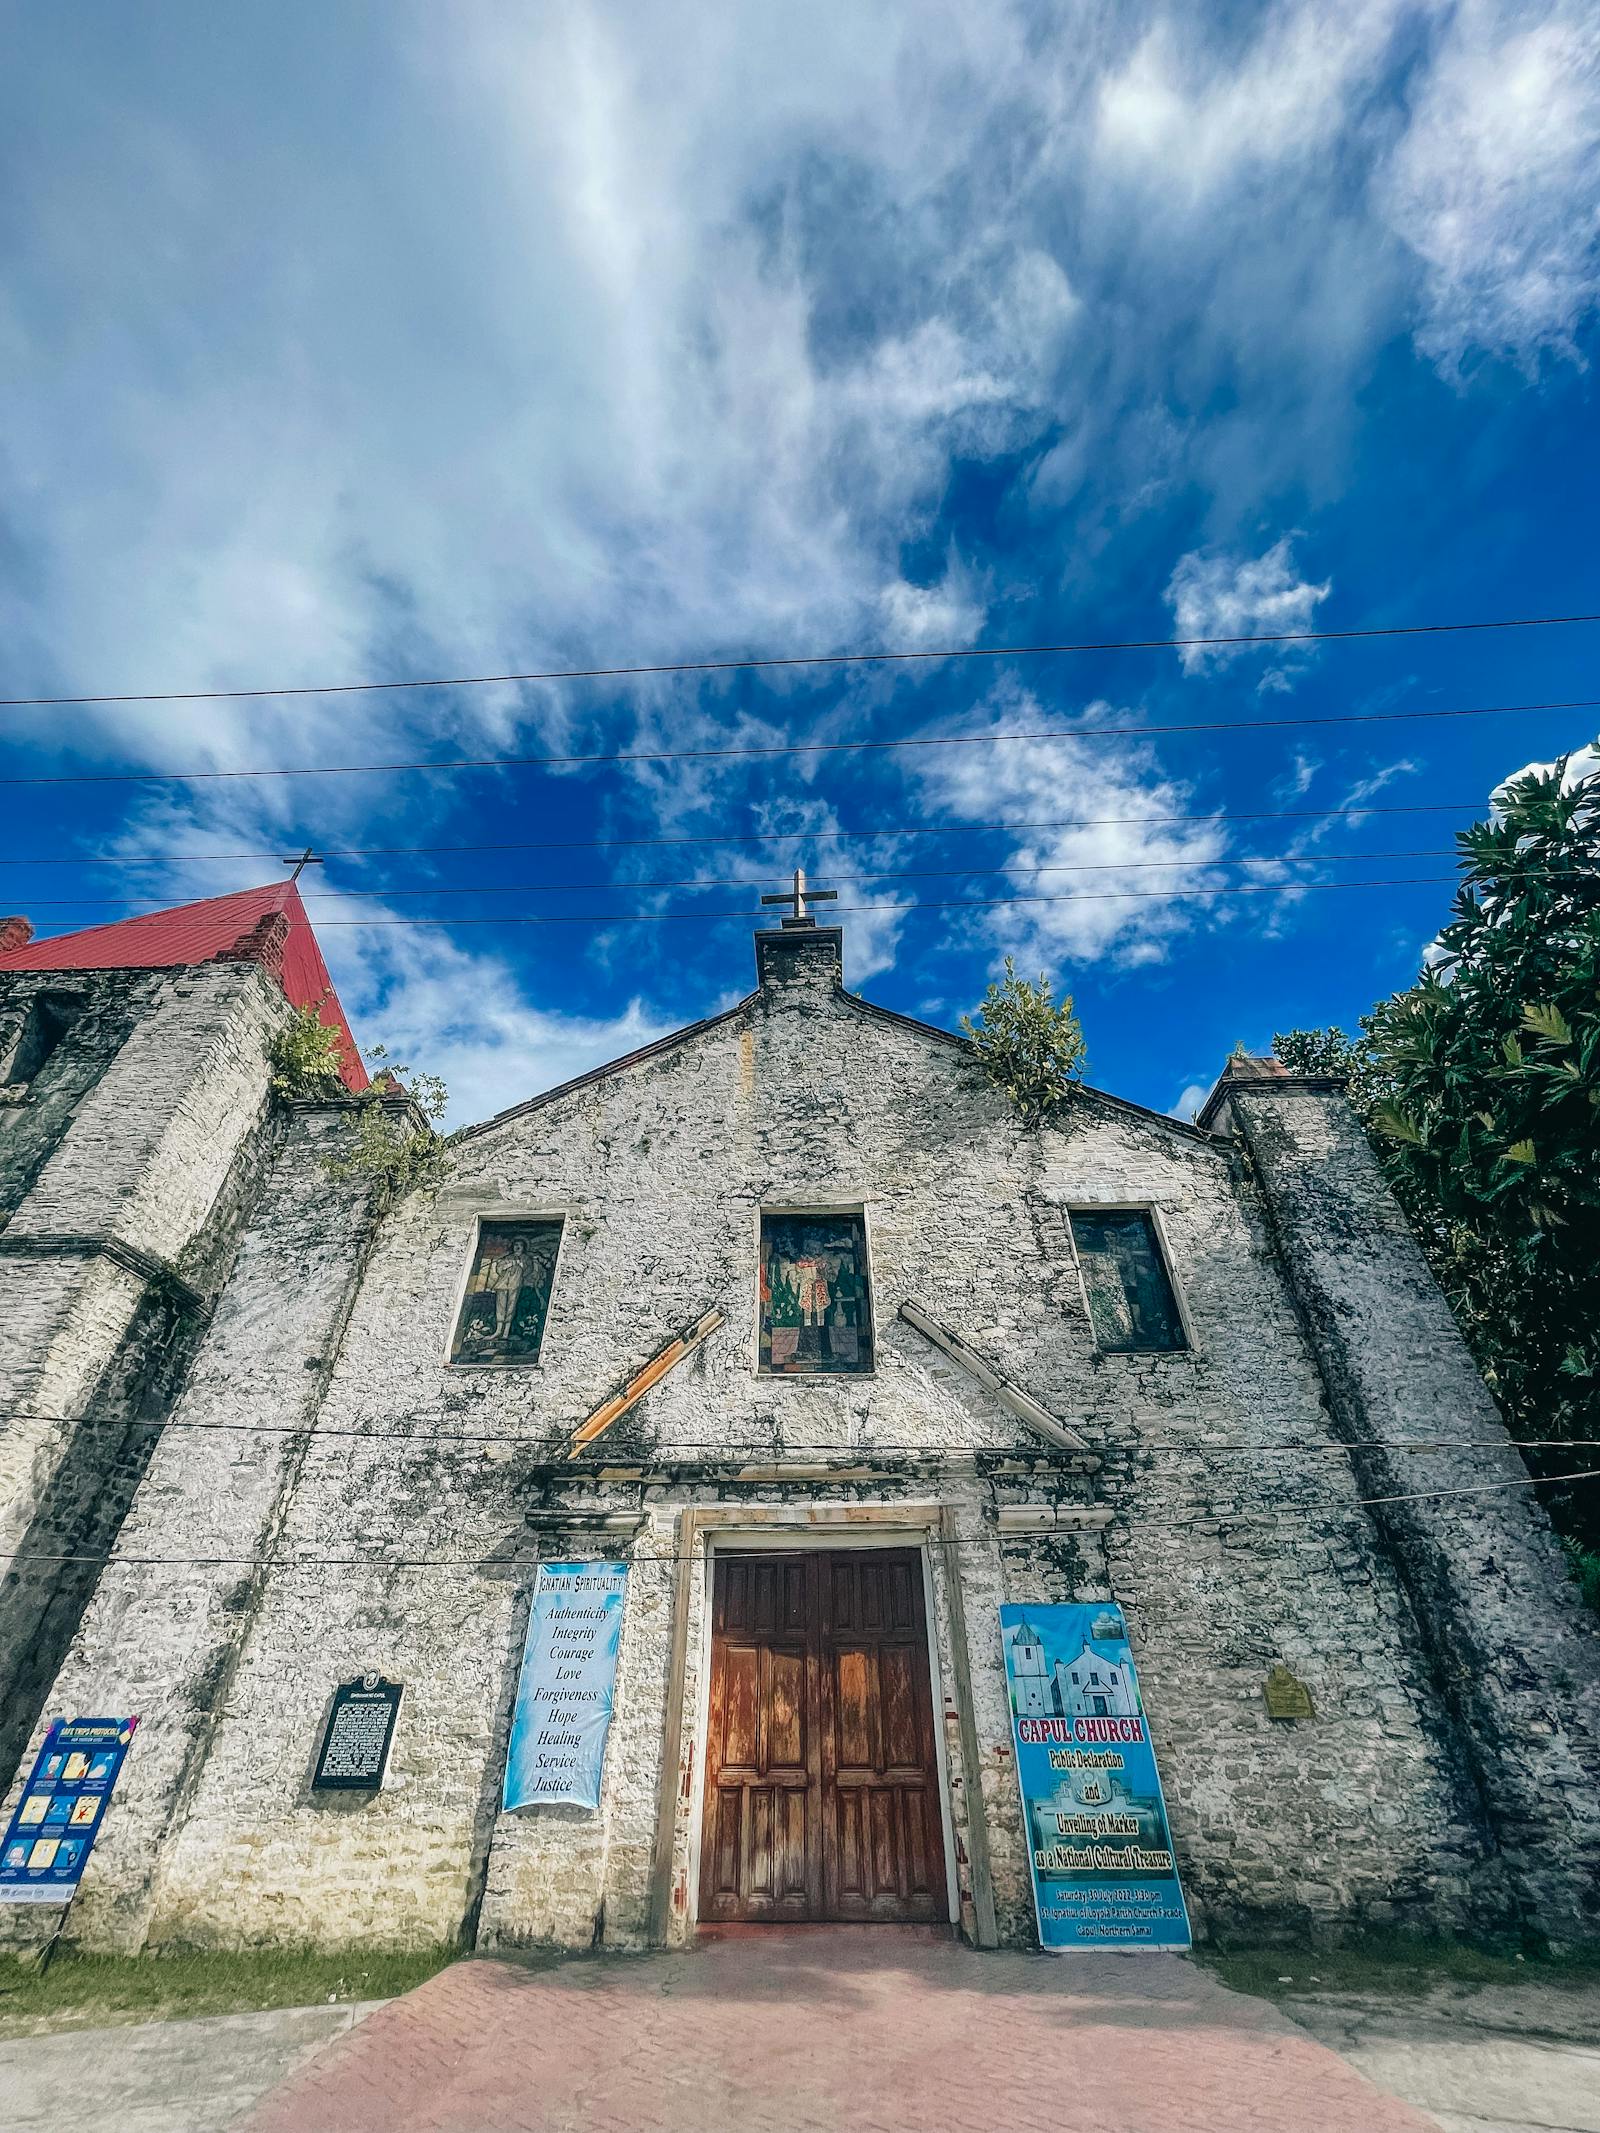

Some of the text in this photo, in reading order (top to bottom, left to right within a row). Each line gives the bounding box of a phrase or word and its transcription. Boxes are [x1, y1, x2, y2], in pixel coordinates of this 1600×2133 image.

[539, 1575, 623, 1593] IGNATIAN SPIRITUALITY
[545, 1606, 609, 1622] Authenticity
[551, 1626, 597, 1642] Integrity
[549, 1646, 595, 1662] Courage
[555, 1666, 582, 1680] Love
[533, 1687, 599, 1705] Forgiveness
[547, 1708, 578, 1726] Hope
[1019, 1718, 1145, 1743] CAPUL CHURCH
[537, 1730, 582, 1749] Healing
[535, 1753, 577, 1769] Service
[1049, 1749, 1124, 1769] Public Declaration
[532, 1776, 573, 1793] Justice
[1084, 1783, 1100, 1800] and
[1056, 1813, 1139, 1839] Unveiling of Marker
[1035, 1845, 1173, 1869] as a National Cultural Treasure
[1050, 1907, 1079, 1921] Ignatius
[1089, 1907, 1111, 1922] Loyola
[1111, 1907, 1133, 1919] Parish
[1133, 1907, 1158, 1919] Church
[1099, 1925, 1131, 1937] Northern
[1131, 1925, 1153, 1937] Samar
